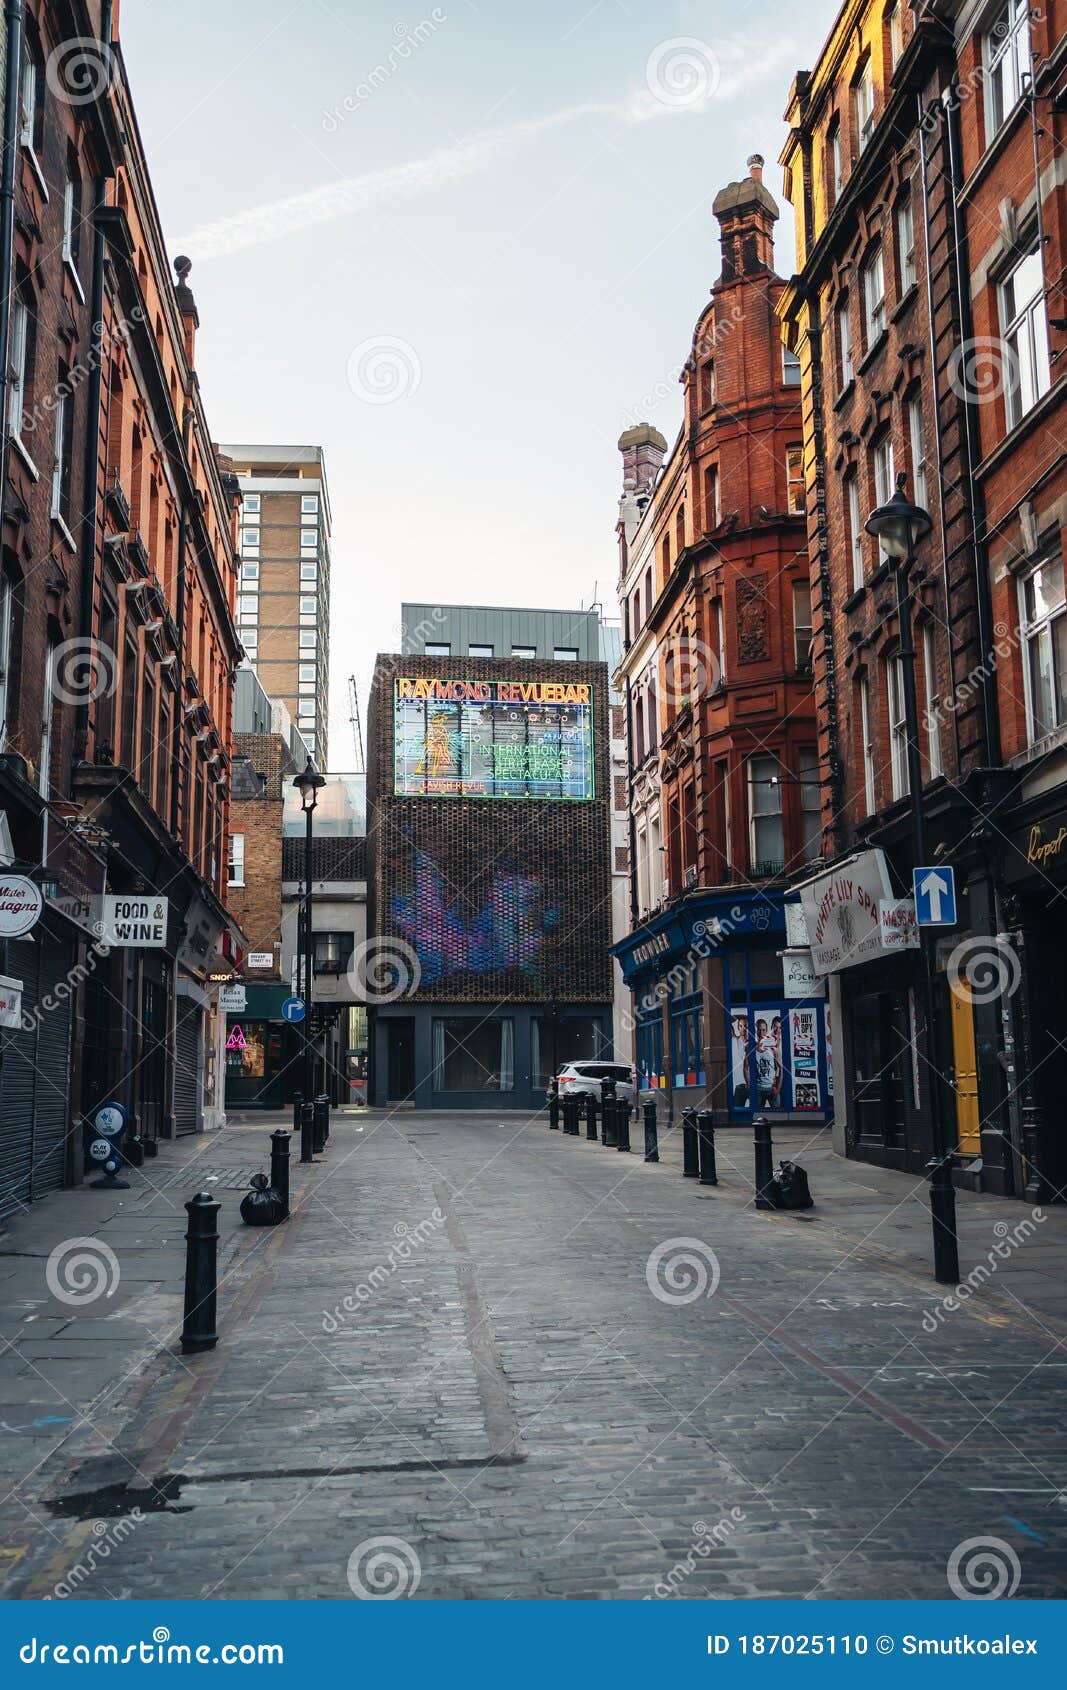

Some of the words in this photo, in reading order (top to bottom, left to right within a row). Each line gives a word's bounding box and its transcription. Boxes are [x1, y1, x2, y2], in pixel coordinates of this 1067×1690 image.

[398, 678, 490, 700] RAYMOND
[497, 682, 590, 704] REVUEBAR
[479, 744, 574, 757] INTERNATIONAL
[488, 768, 571, 780] SPECTACULAR
[0, 901, 39, 914] sagna
[115, 902, 149, 919] FOOD
[815, 887, 836, 945] WHITE
[835, 876, 854, 901] LILY
[857, 885, 879, 925] SPA
[882, 910, 917, 928] MASSA
[115, 923, 163, 941] WINE
[788, 973, 818, 982] POCH
[800, 1013, 813, 1023] GUY
[800, 1023, 813, 1033] SPY
